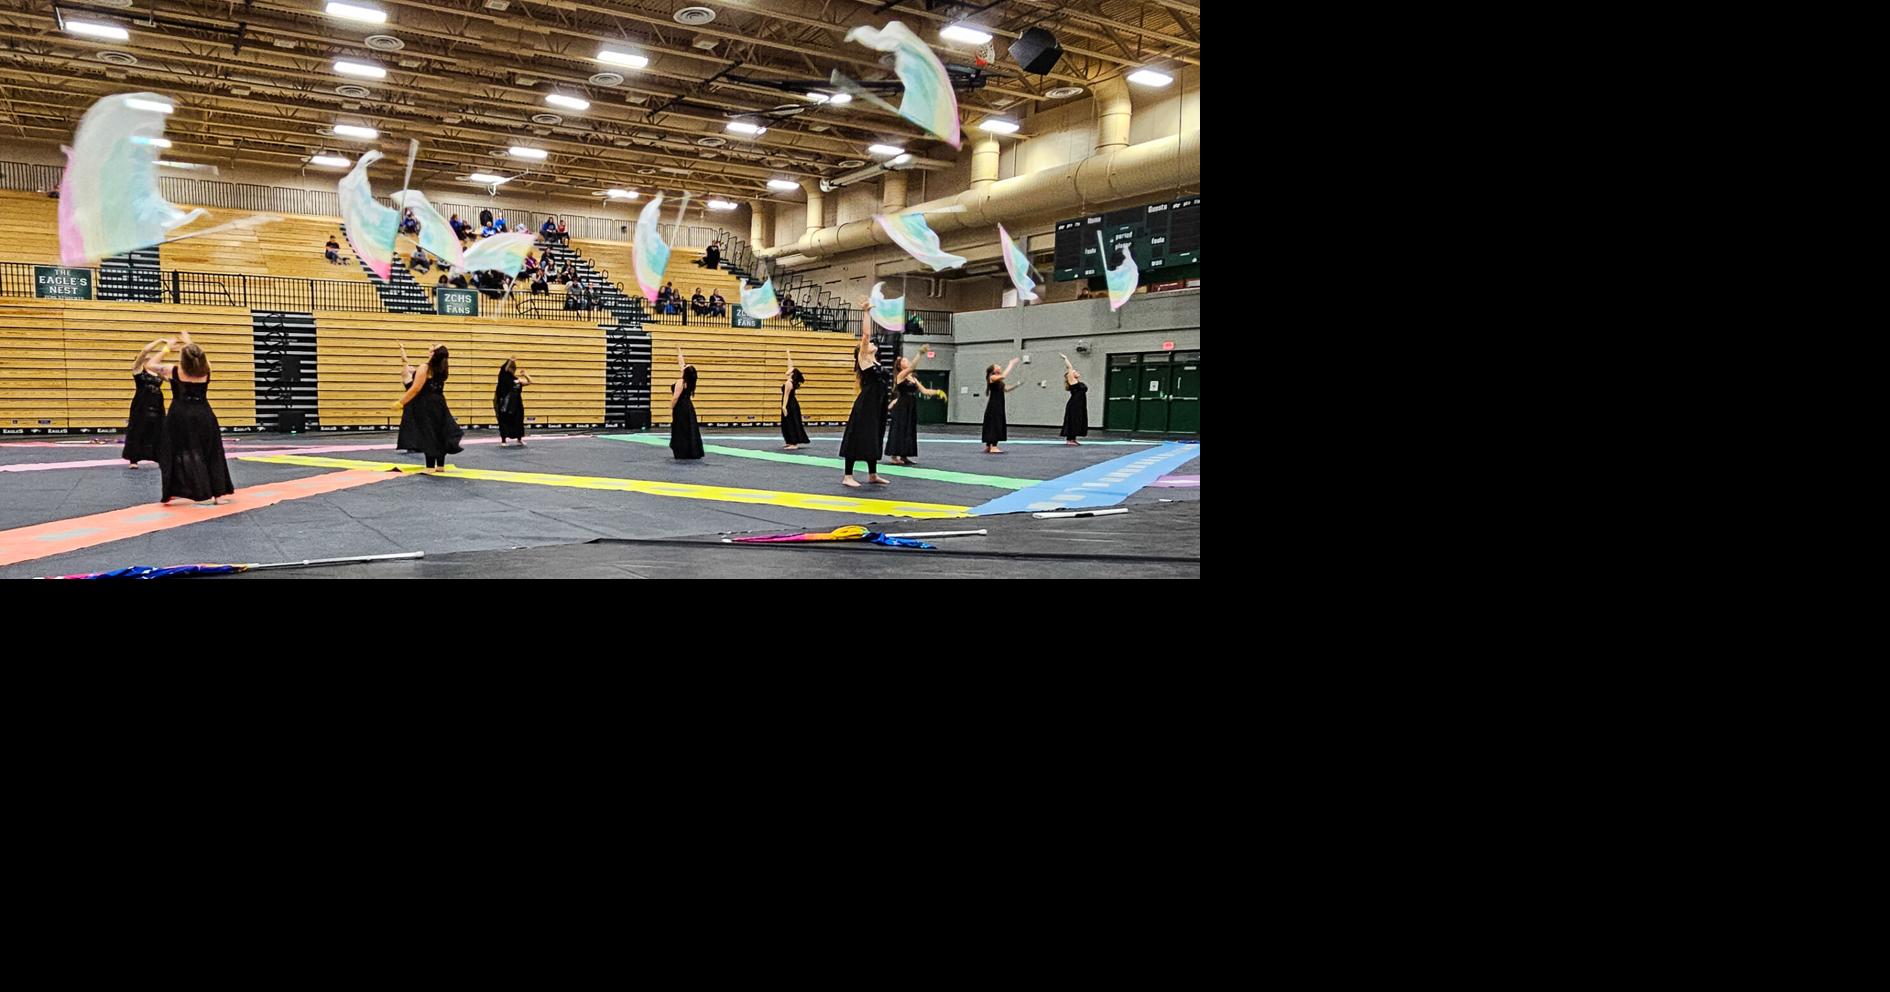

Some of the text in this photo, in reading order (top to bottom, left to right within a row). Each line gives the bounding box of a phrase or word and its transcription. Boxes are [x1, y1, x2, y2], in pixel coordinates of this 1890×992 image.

[39, 276, 87, 287] EAGLE'S
[49, 286, 78, 294] NEST
[444, 293, 472, 303] ZCHS
[446, 304, 470, 314] FANS
[737, 319, 756, 327] FANS
